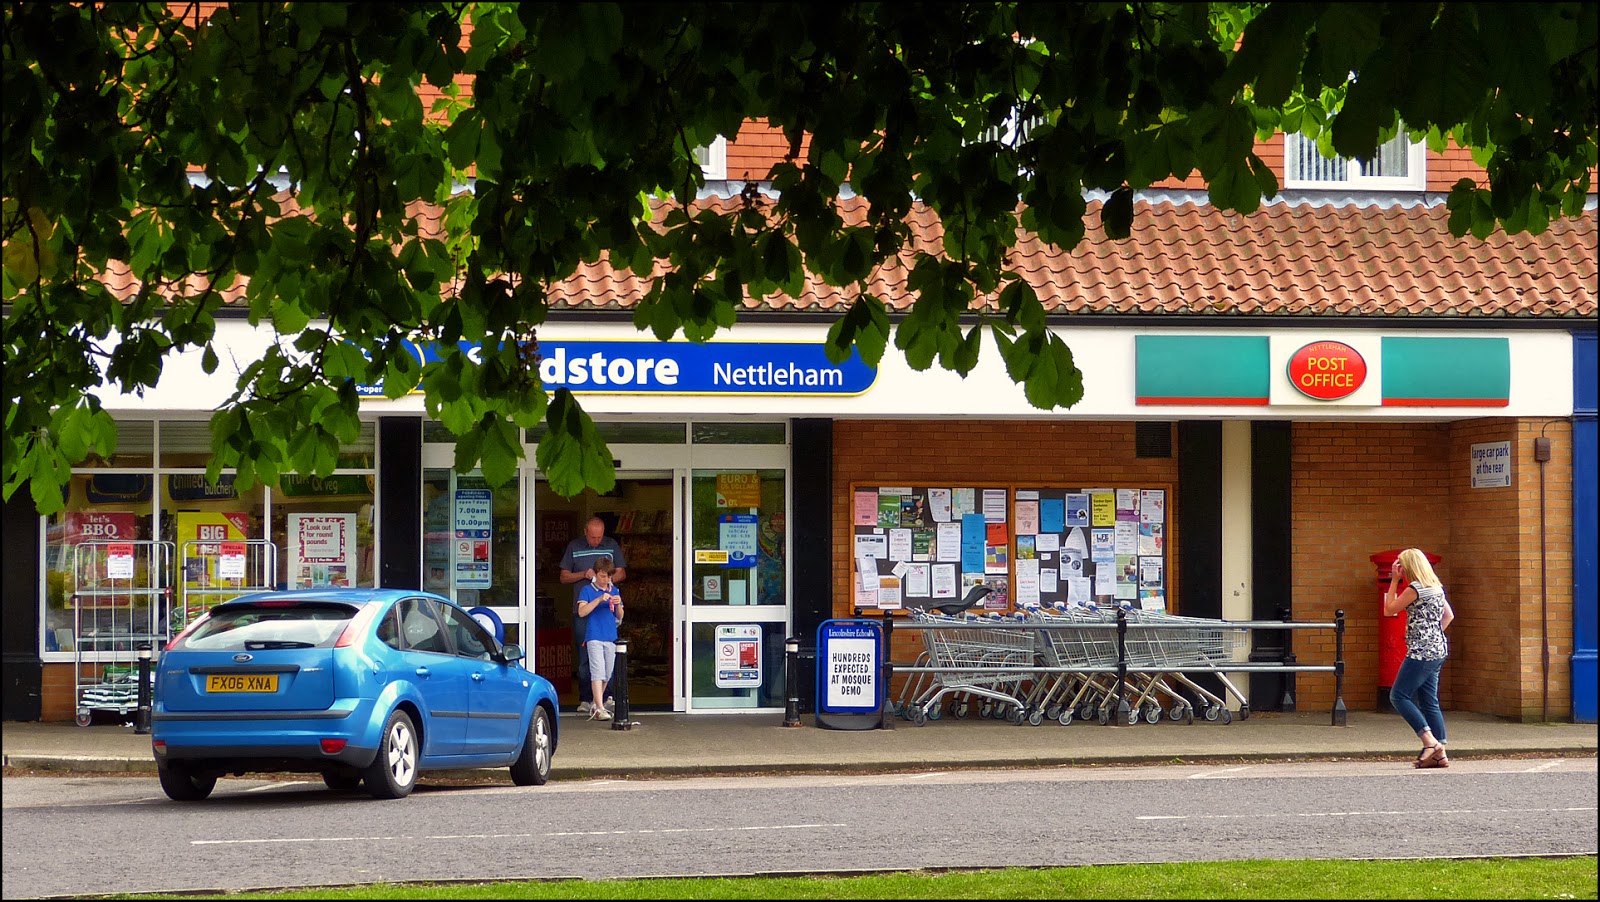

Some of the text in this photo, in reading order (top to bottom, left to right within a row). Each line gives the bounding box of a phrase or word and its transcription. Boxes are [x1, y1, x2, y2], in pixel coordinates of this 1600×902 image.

[1308, 344, 1347, 352] NETTLEHAM
[467, 346, 843, 386] dstore Nettleham
[1308, 357, 1348, 371] POST
[1301, 373, 1354, 387] OFFICE
[1472, 443, 1509, 462] large car park
[1476, 461, 1504, 475] at the rear
[720, 474, 748, 484] EURO
[89, 515, 110, 523] let's
[456, 519, 490, 527] 10.00pm
[81, 523, 120, 539] BBQ
[200, 525, 225, 540] BIG
[540, 645, 572, 667] BIG BIG
[832, 652, 871, 663] HUNDREDS
[834, 664, 869, 673] EXPECTED
[211, 676, 271, 690] FX06 XNA
[831, 674, 871, 686] AT MOSQUE
[841, 685, 861, 696] DEMO
